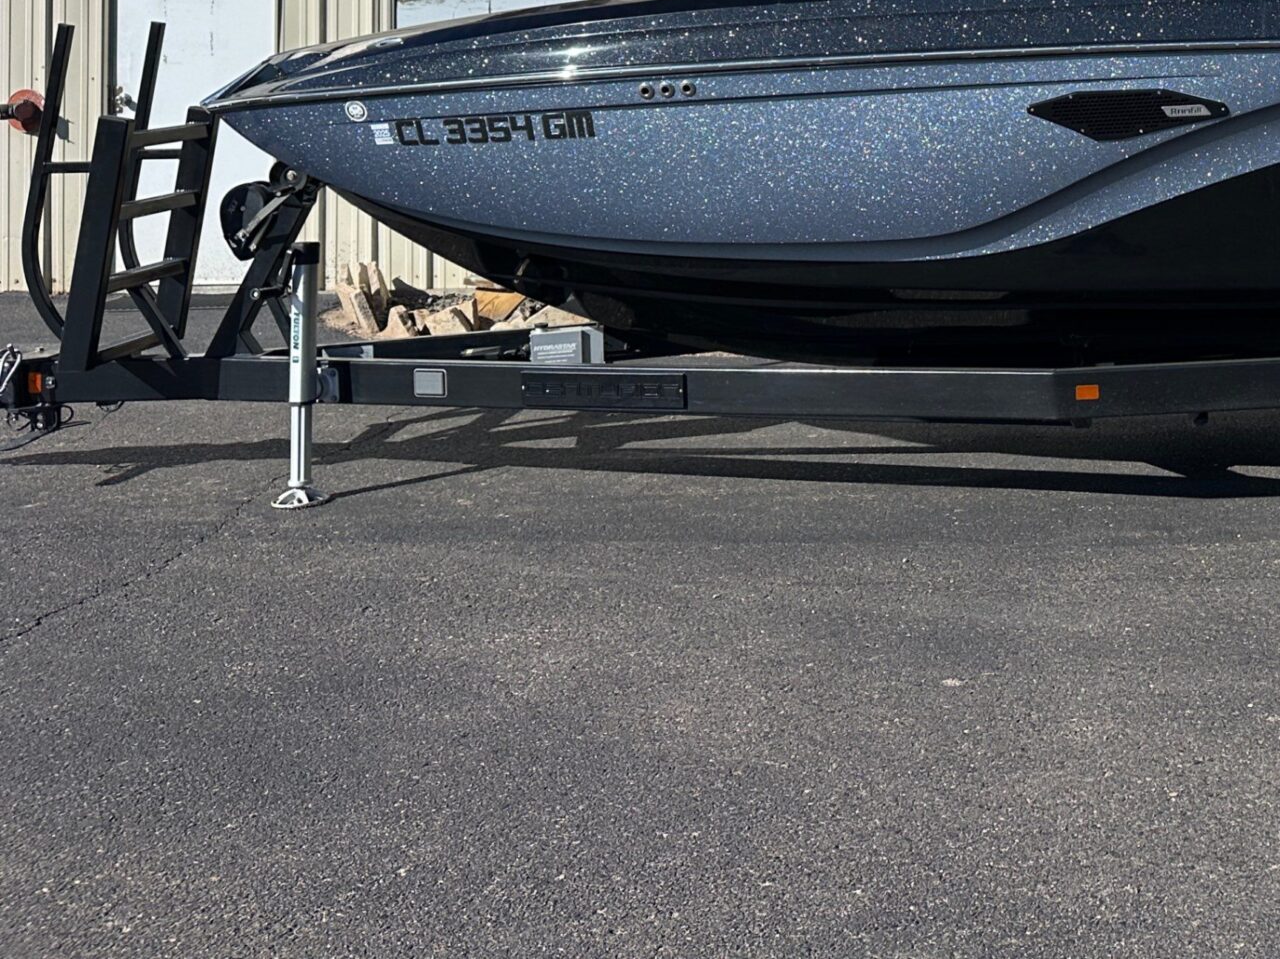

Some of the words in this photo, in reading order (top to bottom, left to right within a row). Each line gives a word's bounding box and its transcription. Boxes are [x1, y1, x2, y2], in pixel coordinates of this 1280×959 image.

[395, 119, 440, 146] CL
[443, 114, 537, 144] 3354
[541, 110, 597, 140] GM
